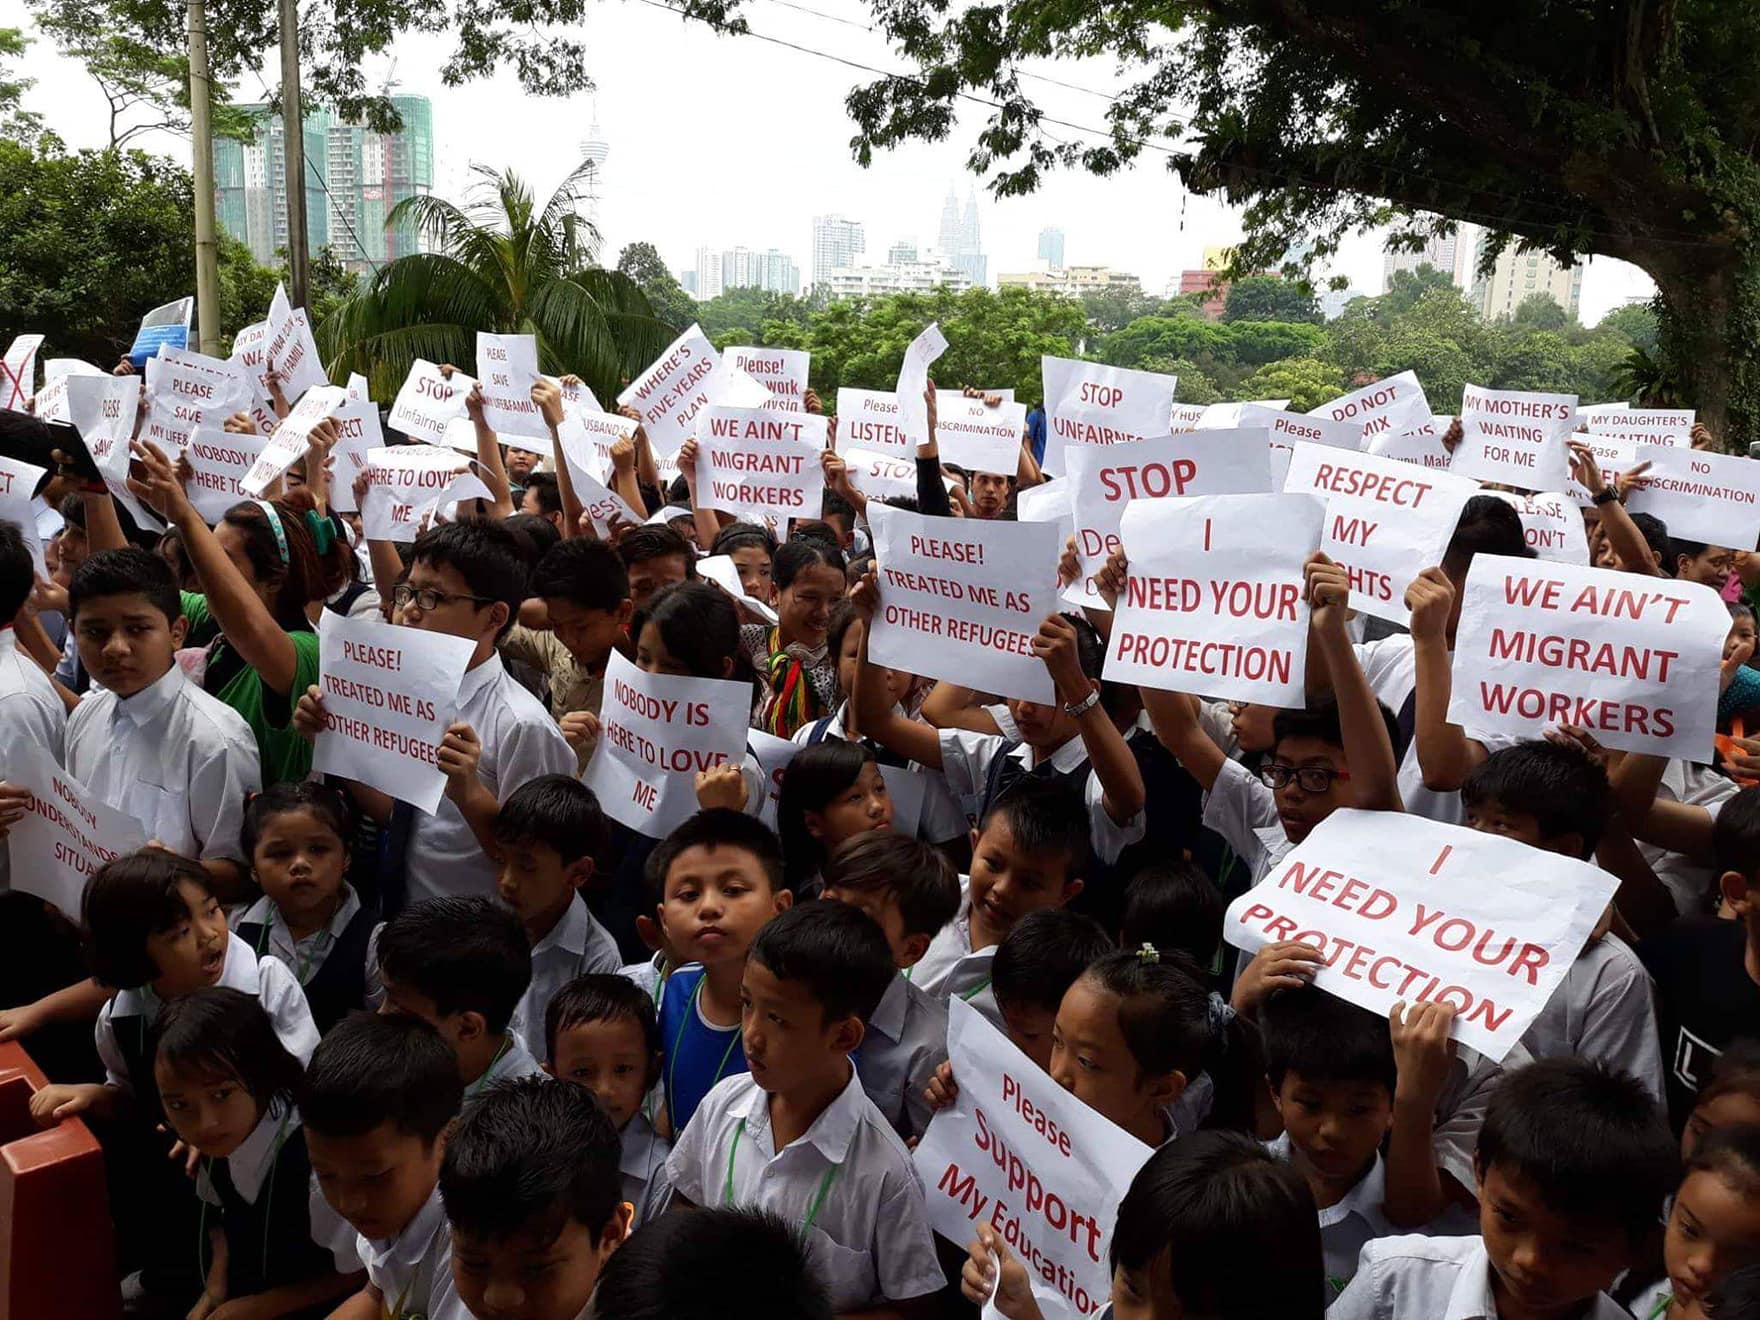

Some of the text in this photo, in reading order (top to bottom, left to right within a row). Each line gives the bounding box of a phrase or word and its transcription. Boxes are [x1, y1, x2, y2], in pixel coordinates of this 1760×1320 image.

[486, 348, 507, 362] PLEASE
[736, 355, 785, 375] Please!
[492, 373, 509, 387] SAVE
[635, 344, 692, 401] WHERE'S
[172, 378, 213, 399] PLEASE
[416, 376, 453, 403] STOP
[646, 357, 713, 425] FIVE-YEARS
[766, 378, 799, 396] work
[1080, 382, 1123, 409] STOP
[174, 406, 202, 424] SAVE
[677, 392, 709, 427] PLAN
[863, 399, 899, 414] Please
[968, 407, 984, 417] NO
[1332, 386, 1396, 422] DO NOT
[1465, 394, 1569, 420] MY MOTHER'S
[150, 424, 165, 439] MY
[337, 418, 363, 438] PECT
[583, 418, 629, 438] USBAND'S
[711, 418, 804, 441] WE AIN'T
[851, 421, 907, 446] LISTEN
[1275, 418, 1322, 439] Please
[1362, 415, 1391, 437] MIX
[1479, 421, 1543, 443] WAITING
[1591, 415, 1687, 426] MY DAUGHTER'S
[192, 443, 248, 467] NOBODY
[711, 450, 805, 475] MIGRANT
[1484, 445, 1536, 468] FOR ME
[1691, 461, 1711, 474] NO
[196, 470, 226, 492] HERE
[368, 468, 394, 486] HERE
[398, 468, 414, 486] TO
[1100, 459, 1197, 502] STOP
[1314, 463, 1432, 508] RESPECT
[712, 480, 804, 506] WORKERS
[392, 504, 413, 522] ME
[1514, 500, 1567, 522] LEASE,
[1204, 518, 1212, 551] I
[1332, 515, 1378, 547] MY
[1525, 528, 1565, 549] ON'T
[911, 535, 984, 565] PLEASE!
[884, 568, 1031, 613] TREATED ME AS
[1127, 576, 1200, 612] NEED
[1211, 580, 1298, 622] YOUR
[1504, 575, 1689, 625] WE AIN'T
[886, 605, 942, 635] OTHER
[344, 640, 401, 672] PLEASE!
[1117, 632, 1291, 684] PROTECTION
[1489, 628, 1679, 683] MIGRANT
[323, 674, 436, 722] TREATED ME AS
[615, 678, 710, 726] NOBODY IS
[1480, 681, 1675, 738] WORKERS
[327, 714, 370, 744] OTHER
[607, 718, 635, 753] HERE
[637, 736, 655, 764] TO
[52, 775, 97, 830] NOBODY
[632, 780, 657, 812] ME
[54, 841, 99, 876] SITUA
[1429, 845, 1453, 876] I
[1278, 860, 1550, 986] NEED YOUR
[1003, 1073, 1071, 1158] Please
[938, 1163, 988, 1220] My
[974, 1108, 1102, 1263] Support
